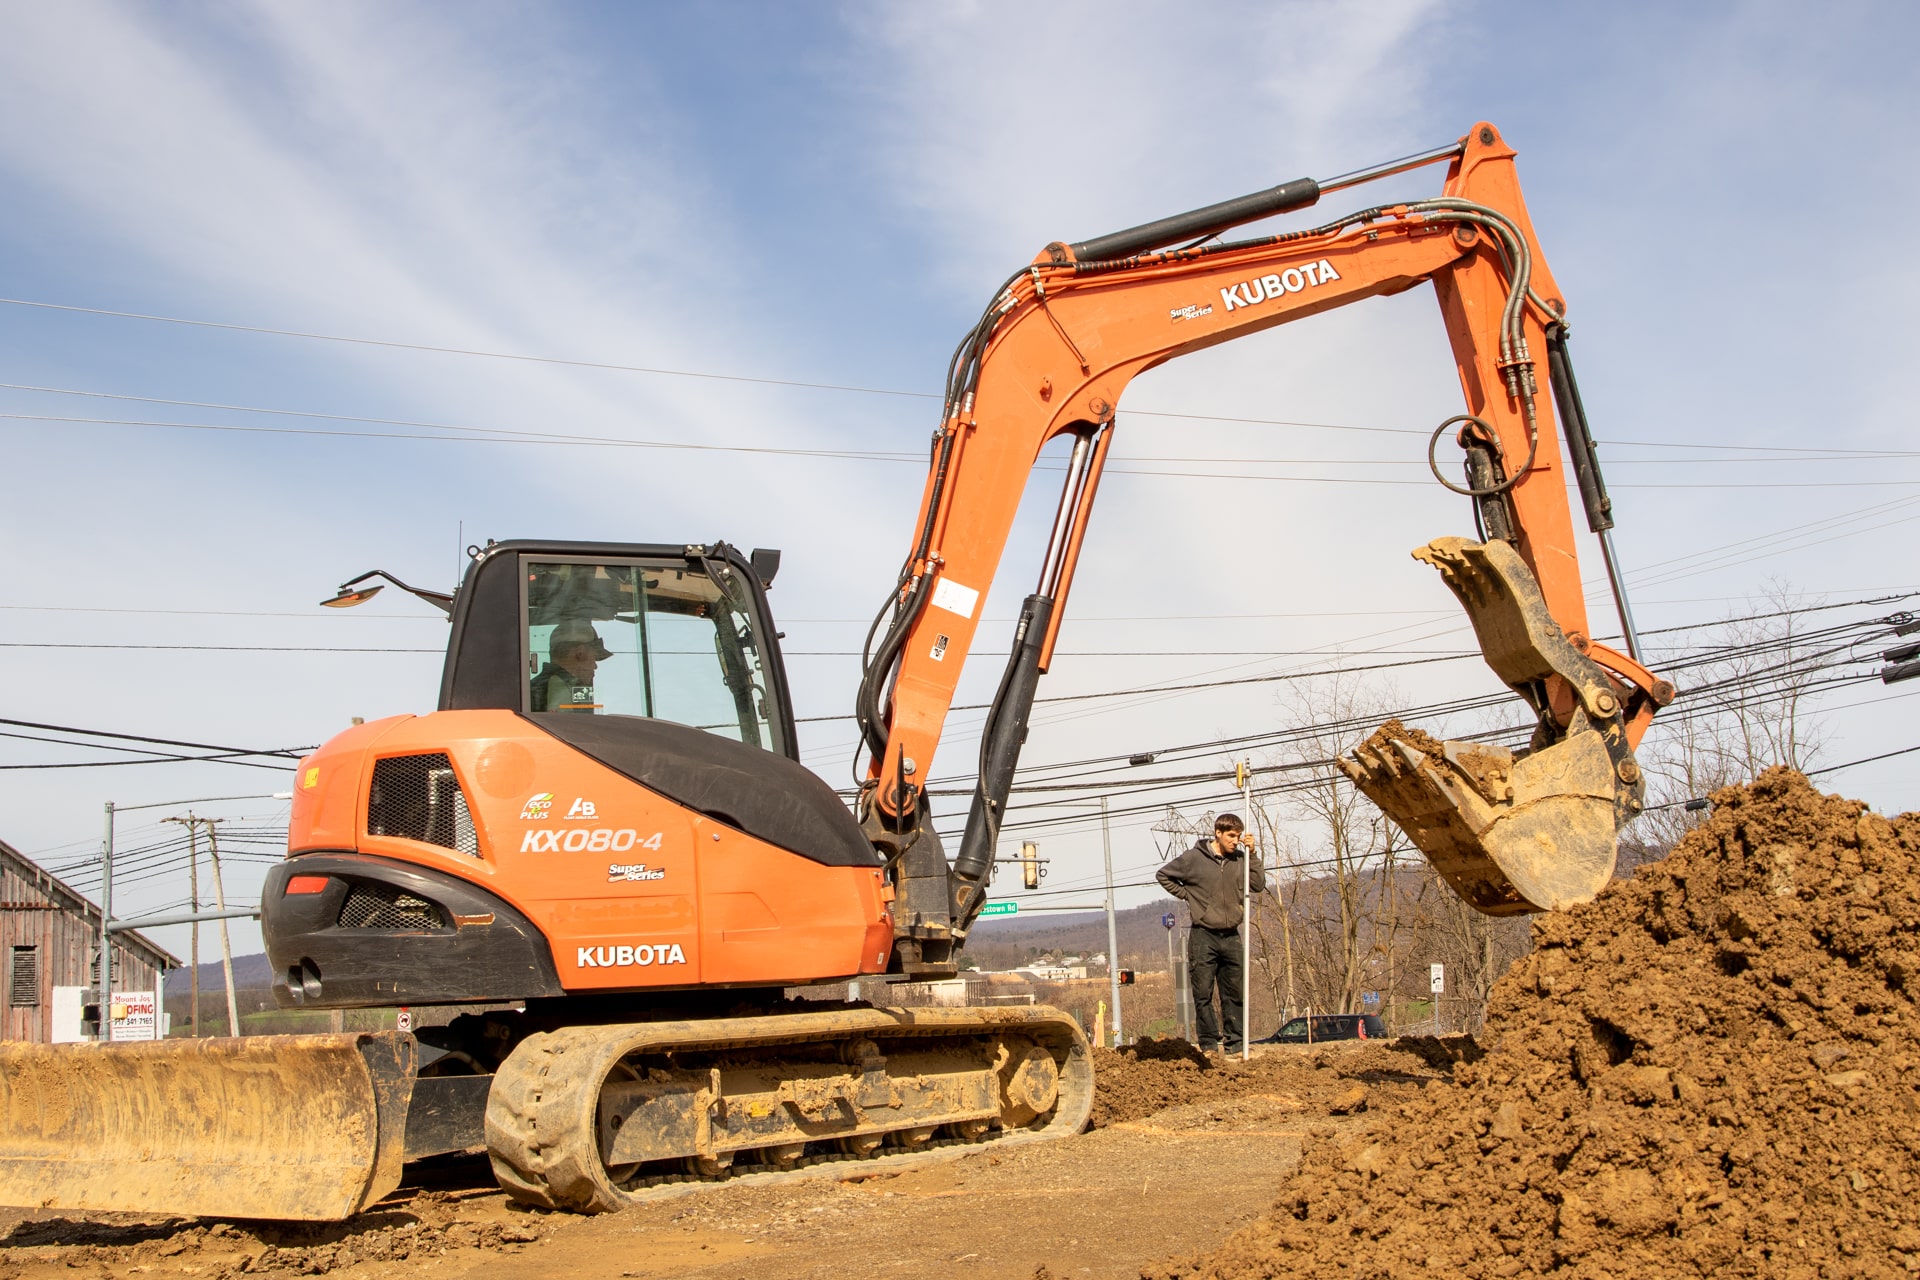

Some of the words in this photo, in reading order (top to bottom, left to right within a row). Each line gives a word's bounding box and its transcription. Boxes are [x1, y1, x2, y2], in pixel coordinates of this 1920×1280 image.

[1220, 258, 1341, 312] KUBOTA
[1170, 304, 1197, 318] Super
[1185, 305, 1213, 320] Series
[529, 800, 552, 809] eco
[519, 811, 549, 820] PLUS
[520, 828, 663, 853] KX080-4
[608, 863, 646, 877] Super
[626, 869, 665, 881] Series
[577, 943, 687, 968] KUBOTA
[127, 1004, 153, 1014] OFING
